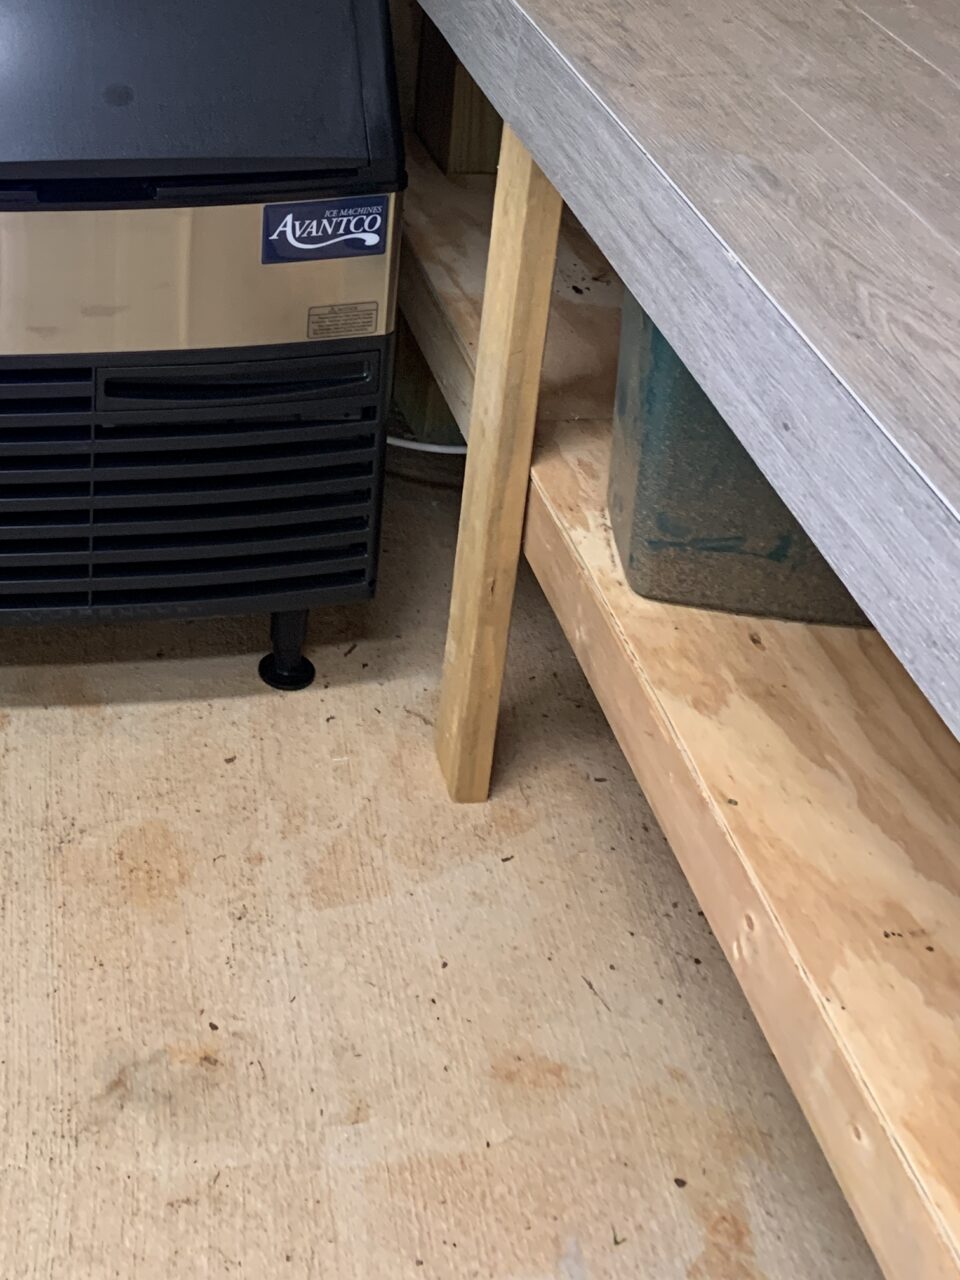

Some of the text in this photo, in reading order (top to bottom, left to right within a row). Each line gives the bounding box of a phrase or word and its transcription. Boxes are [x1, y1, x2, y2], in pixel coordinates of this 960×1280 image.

[324, 205, 383, 218] ICE MACHINES
[268, 212, 382, 249] AVANTCO
